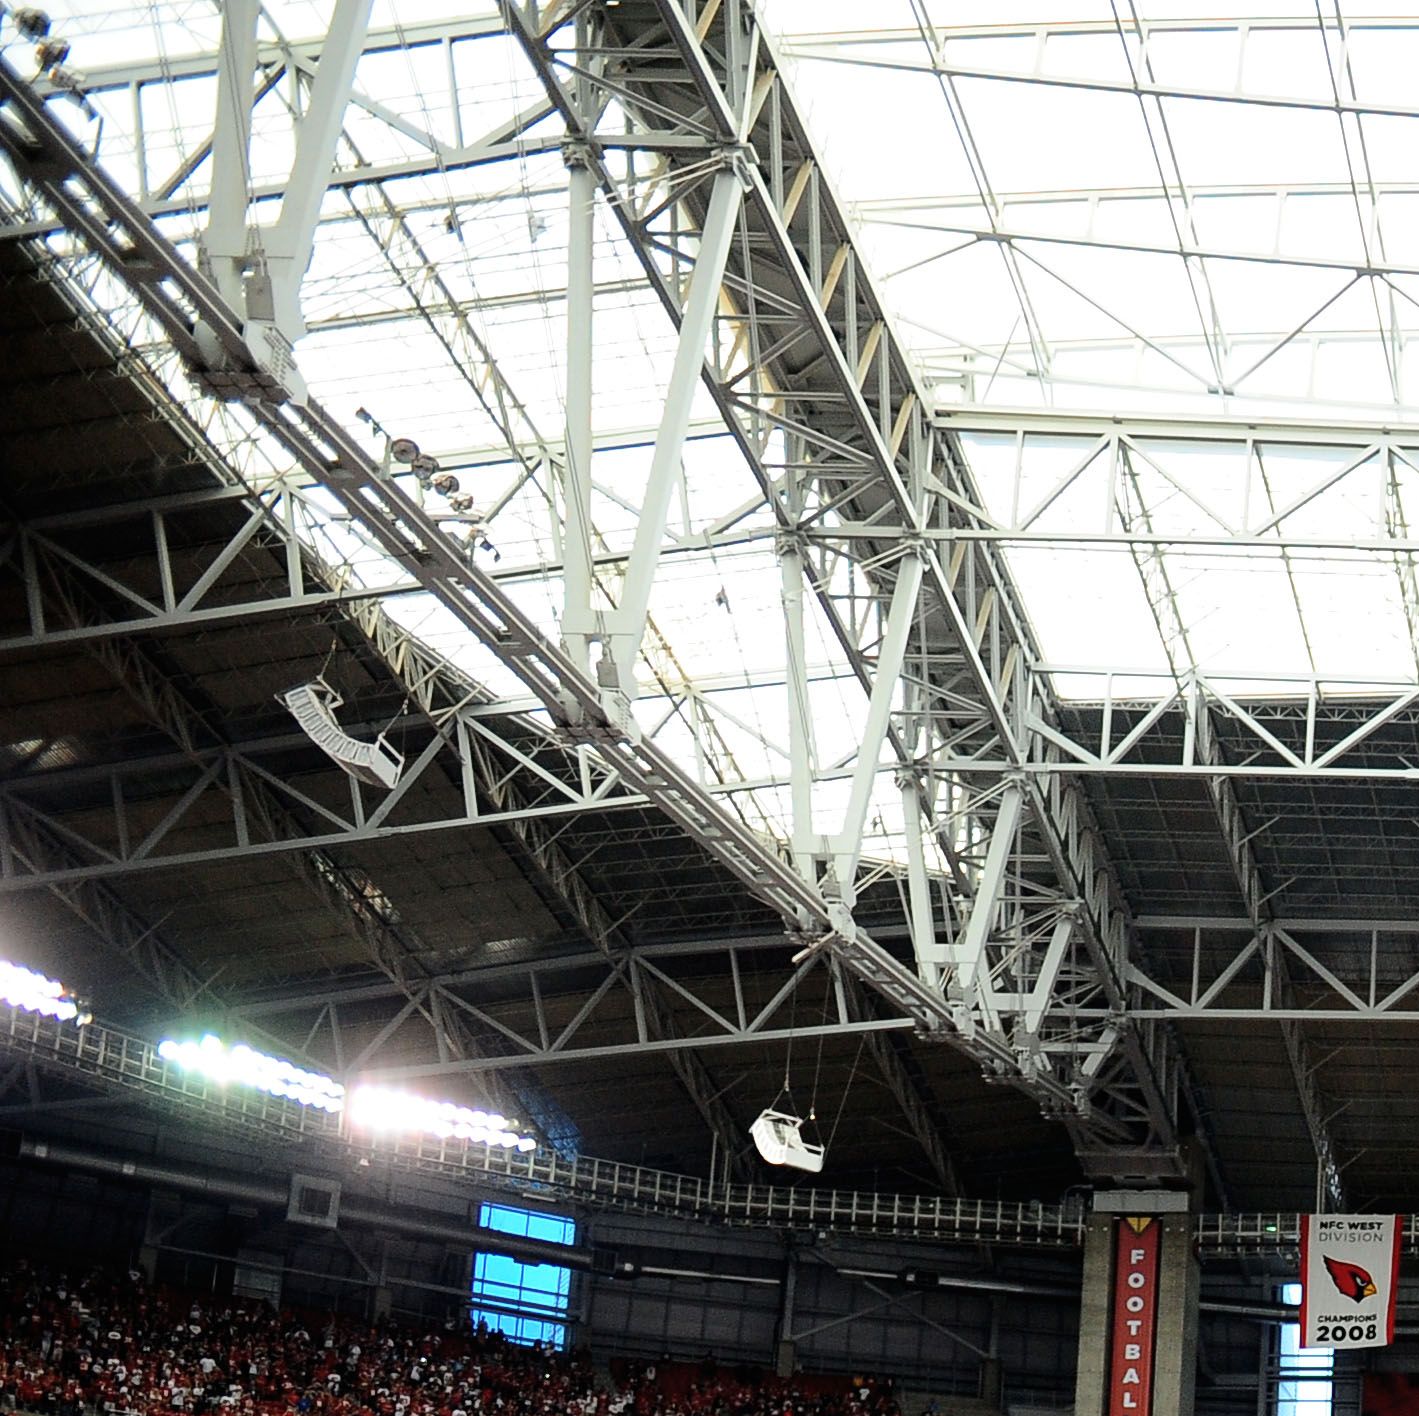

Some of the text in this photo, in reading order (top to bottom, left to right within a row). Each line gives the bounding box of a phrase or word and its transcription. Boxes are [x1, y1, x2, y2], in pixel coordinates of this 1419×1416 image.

[1320, 1221, 1384, 1231] NFC WEST
[1319, 1232, 1383, 1242] DIVISION
[1317, 1314, 1377, 1323] CHAMPIONS
[1316, 1324, 1377, 1342] 2008
